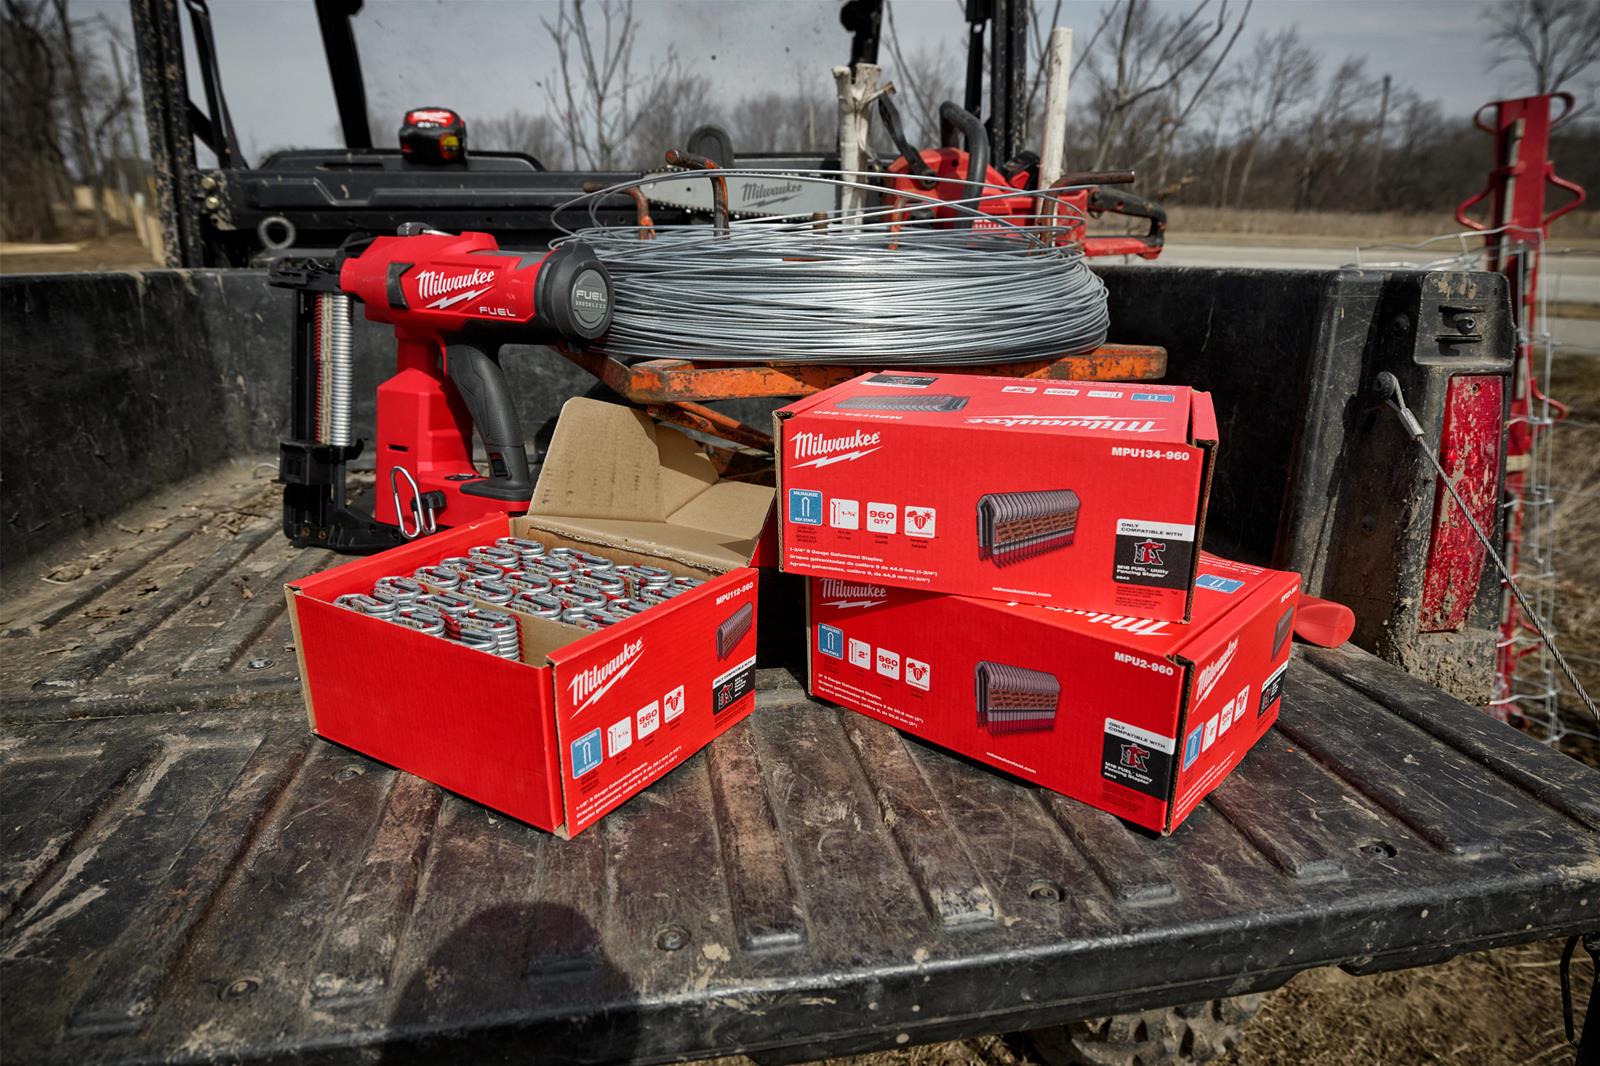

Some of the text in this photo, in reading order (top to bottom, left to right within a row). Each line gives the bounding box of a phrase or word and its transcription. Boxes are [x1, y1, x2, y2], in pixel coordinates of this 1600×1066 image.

[741, 181, 802, 202] Milwaukee
[416, 268, 495, 299] Milwaukee
[576, 290, 606, 302] FUEL
[479, 306, 516, 317] FUEL
[965, 417, 1168, 433] Milwaukee
[789, 429, 880, 459] Milwaukee
[1111, 447, 1190, 461] MPU134-960
[869, 510, 895, 520] 960
[716, 581, 753, 606] MPU112-960
[819, 577, 887, 598] Milwaukee
[879, 655, 898, 666] 960
[882, 663, 894, 671] QTY
[1114, 651, 1174, 676] MPU2-960
[567, 638, 643, 706] Milwaukee
[639, 709, 658, 725] 960
[643, 718, 655, 728] QTY
[1109, 721, 1125, 730] ONLY
[1108, 726, 1166, 748] COMPATIBLE WITH
